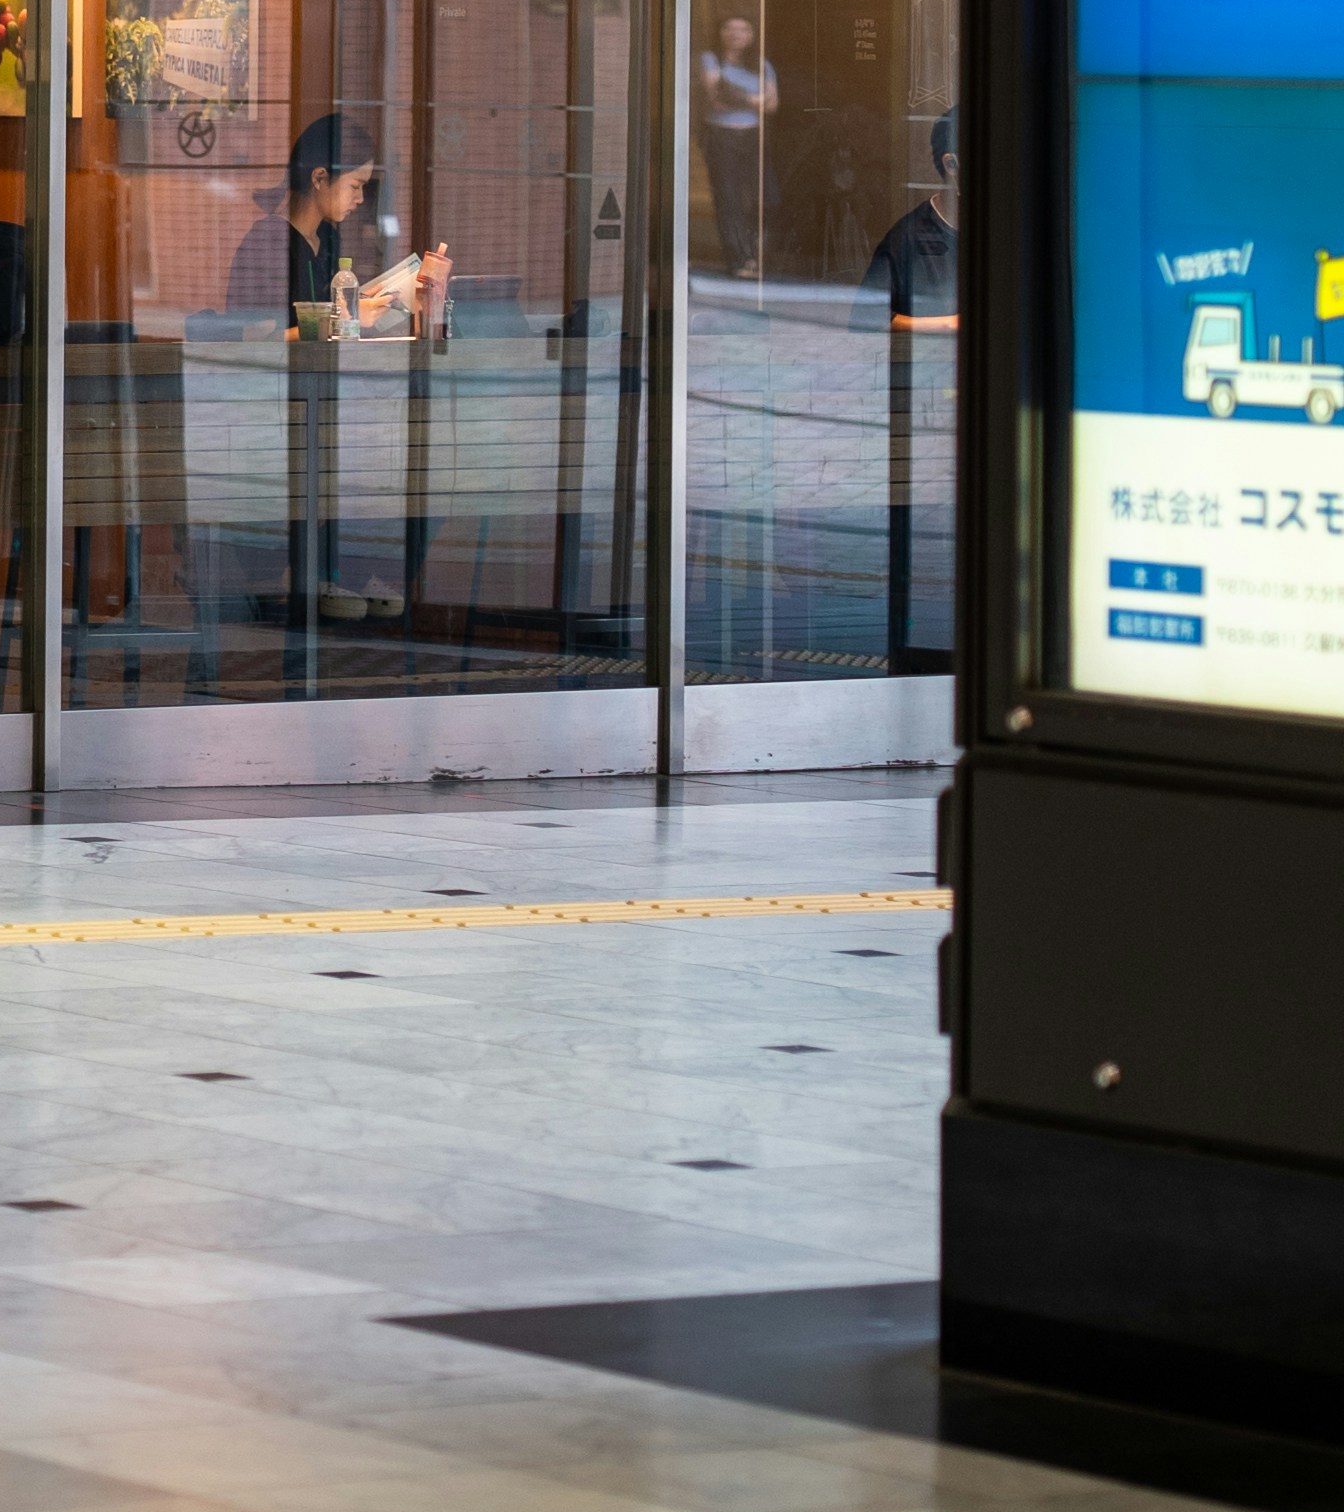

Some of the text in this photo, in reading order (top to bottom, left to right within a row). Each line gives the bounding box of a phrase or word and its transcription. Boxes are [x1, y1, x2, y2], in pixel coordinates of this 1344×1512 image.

[186, 59, 227, 85] VARIETAL
[1110, 486, 1344, 535] 株式会社 コスモ
